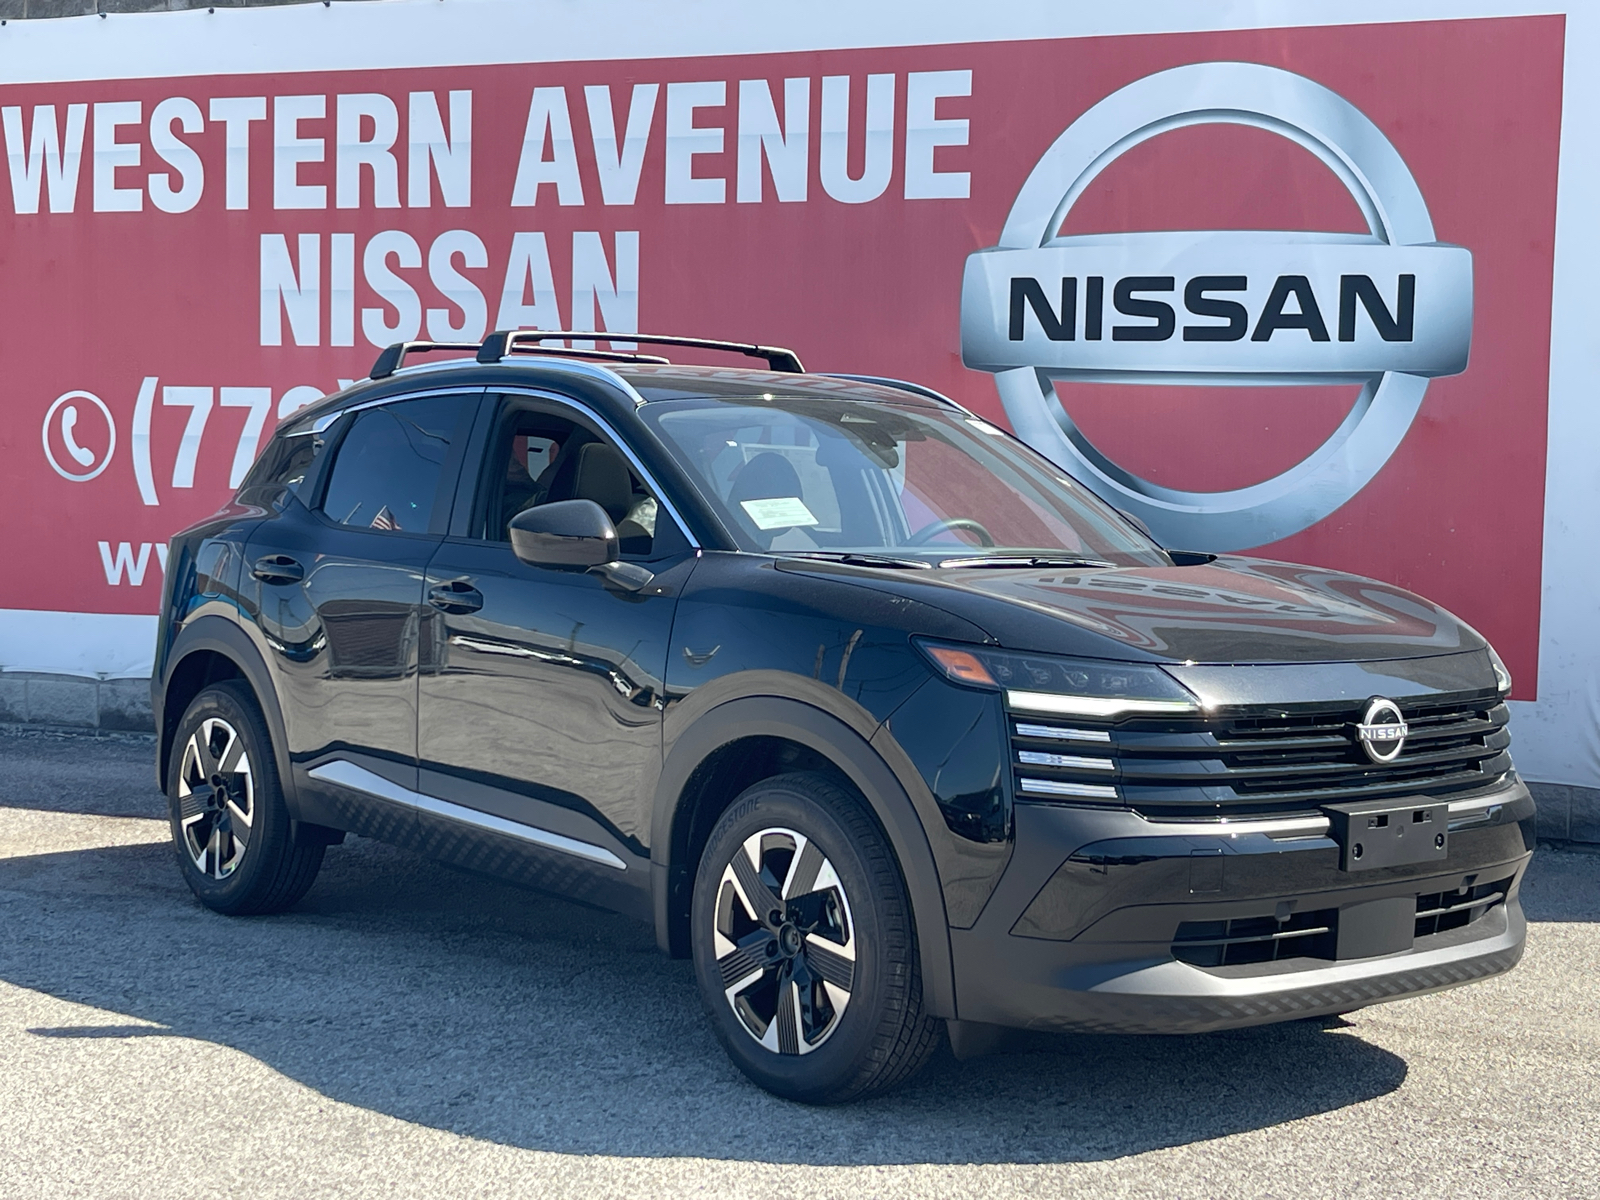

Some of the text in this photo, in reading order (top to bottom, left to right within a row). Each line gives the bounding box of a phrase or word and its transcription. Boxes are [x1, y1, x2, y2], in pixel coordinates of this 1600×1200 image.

[1, 69, 974, 215] WESTERN AVENUE
[259, 229, 640, 351] NISSAN
[1008, 273, 1416, 342] NISSAN
[1360, 725, 1408, 740] NISSAN
